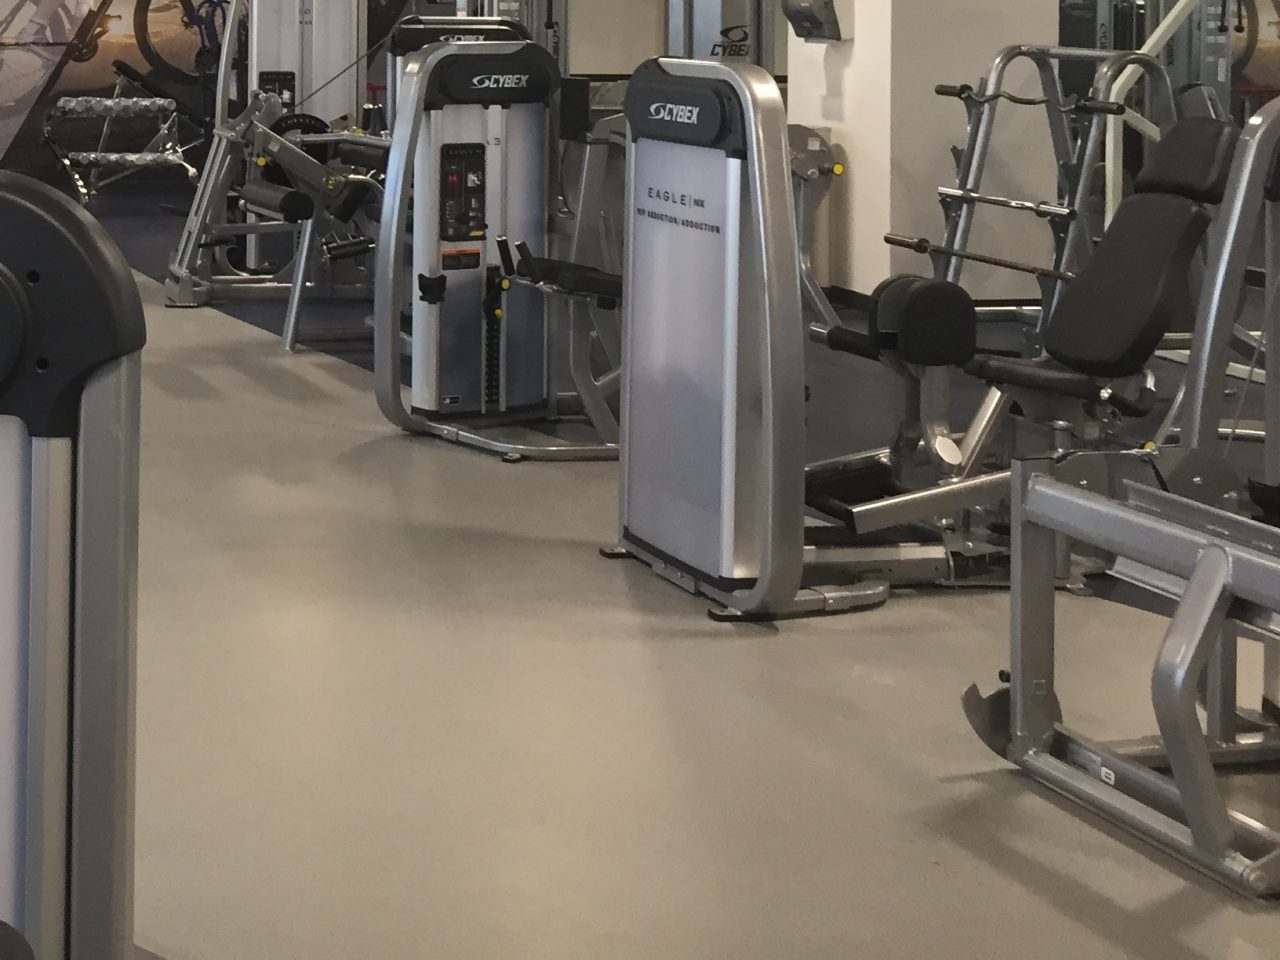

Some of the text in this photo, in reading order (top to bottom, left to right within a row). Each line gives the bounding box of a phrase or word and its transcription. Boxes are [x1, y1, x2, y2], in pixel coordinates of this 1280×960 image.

[710, 43, 750, 57] CYBE
[489, 74, 530, 88] CYBEX
[663, 103, 700, 125] CYBEX
[647, 186, 687, 207] EAGLE
